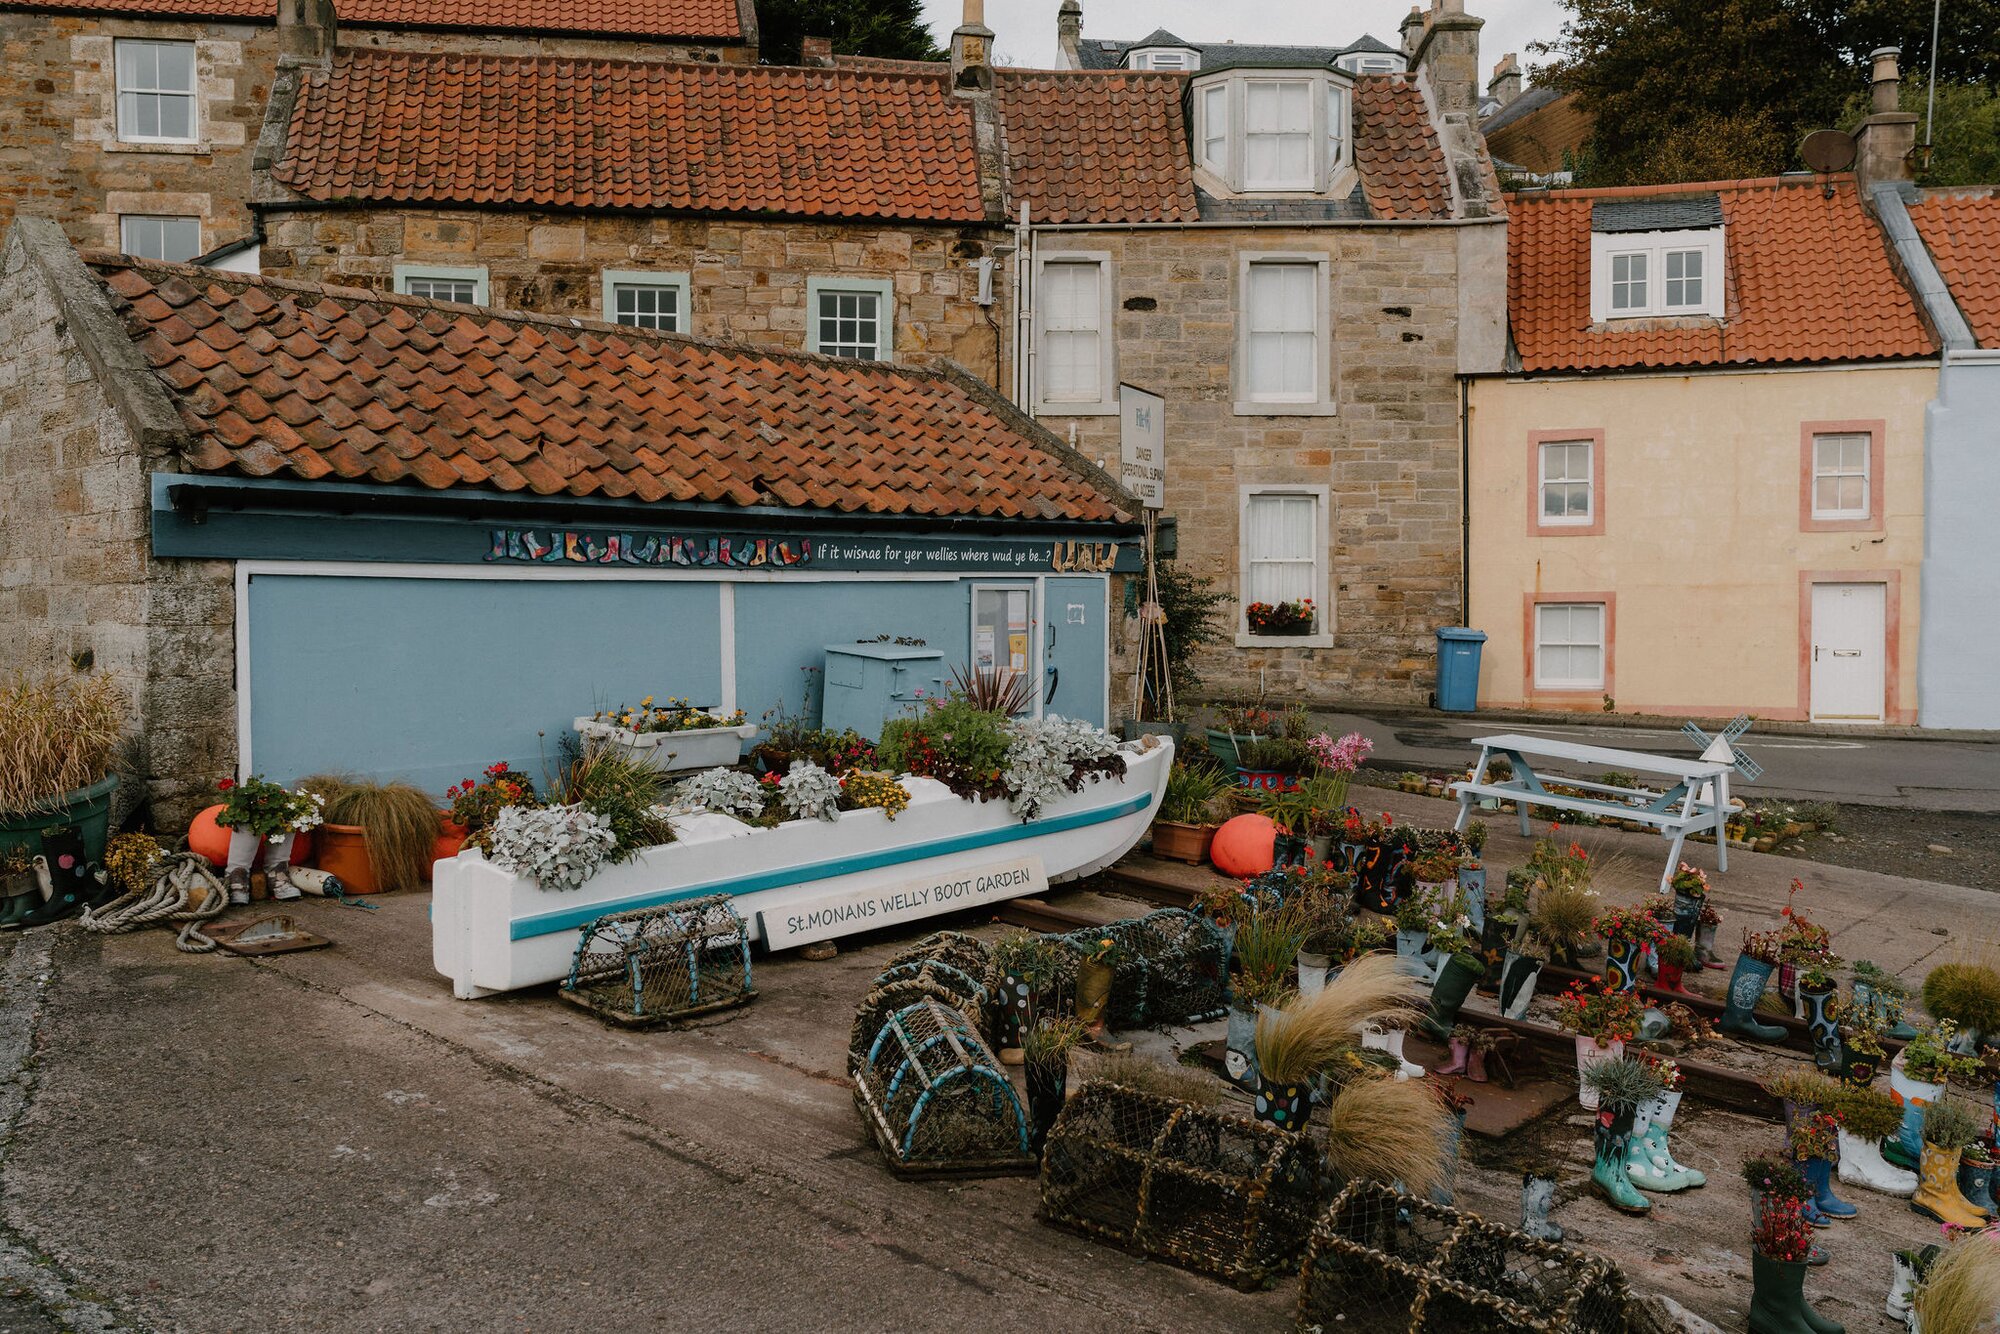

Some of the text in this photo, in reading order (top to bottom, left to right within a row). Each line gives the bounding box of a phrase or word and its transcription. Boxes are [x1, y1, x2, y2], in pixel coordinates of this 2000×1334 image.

[1136, 446, 1152, 462] DANGER
[1122, 462, 1149, 480] OPERATIONAL
[1132, 483, 1155, 498] NO ACCESS
[817, 543, 827, 559] If
[830, 544, 840, 559] it
[843, 545, 881, 560] wisnae
[885, 545, 902, 560] for
[904, 550, 923, 564] yer
[926, 547, 958, 561] wellies
[960, 547, 989, 561] where
[992, 548, 1013, 562] wud
[1015, 551, 1026, 566] ye
[881, 889, 929, 913] WELLY
[934, 880, 971, 902] BOOT
[976, 868, 1031, 893] GARDEN
